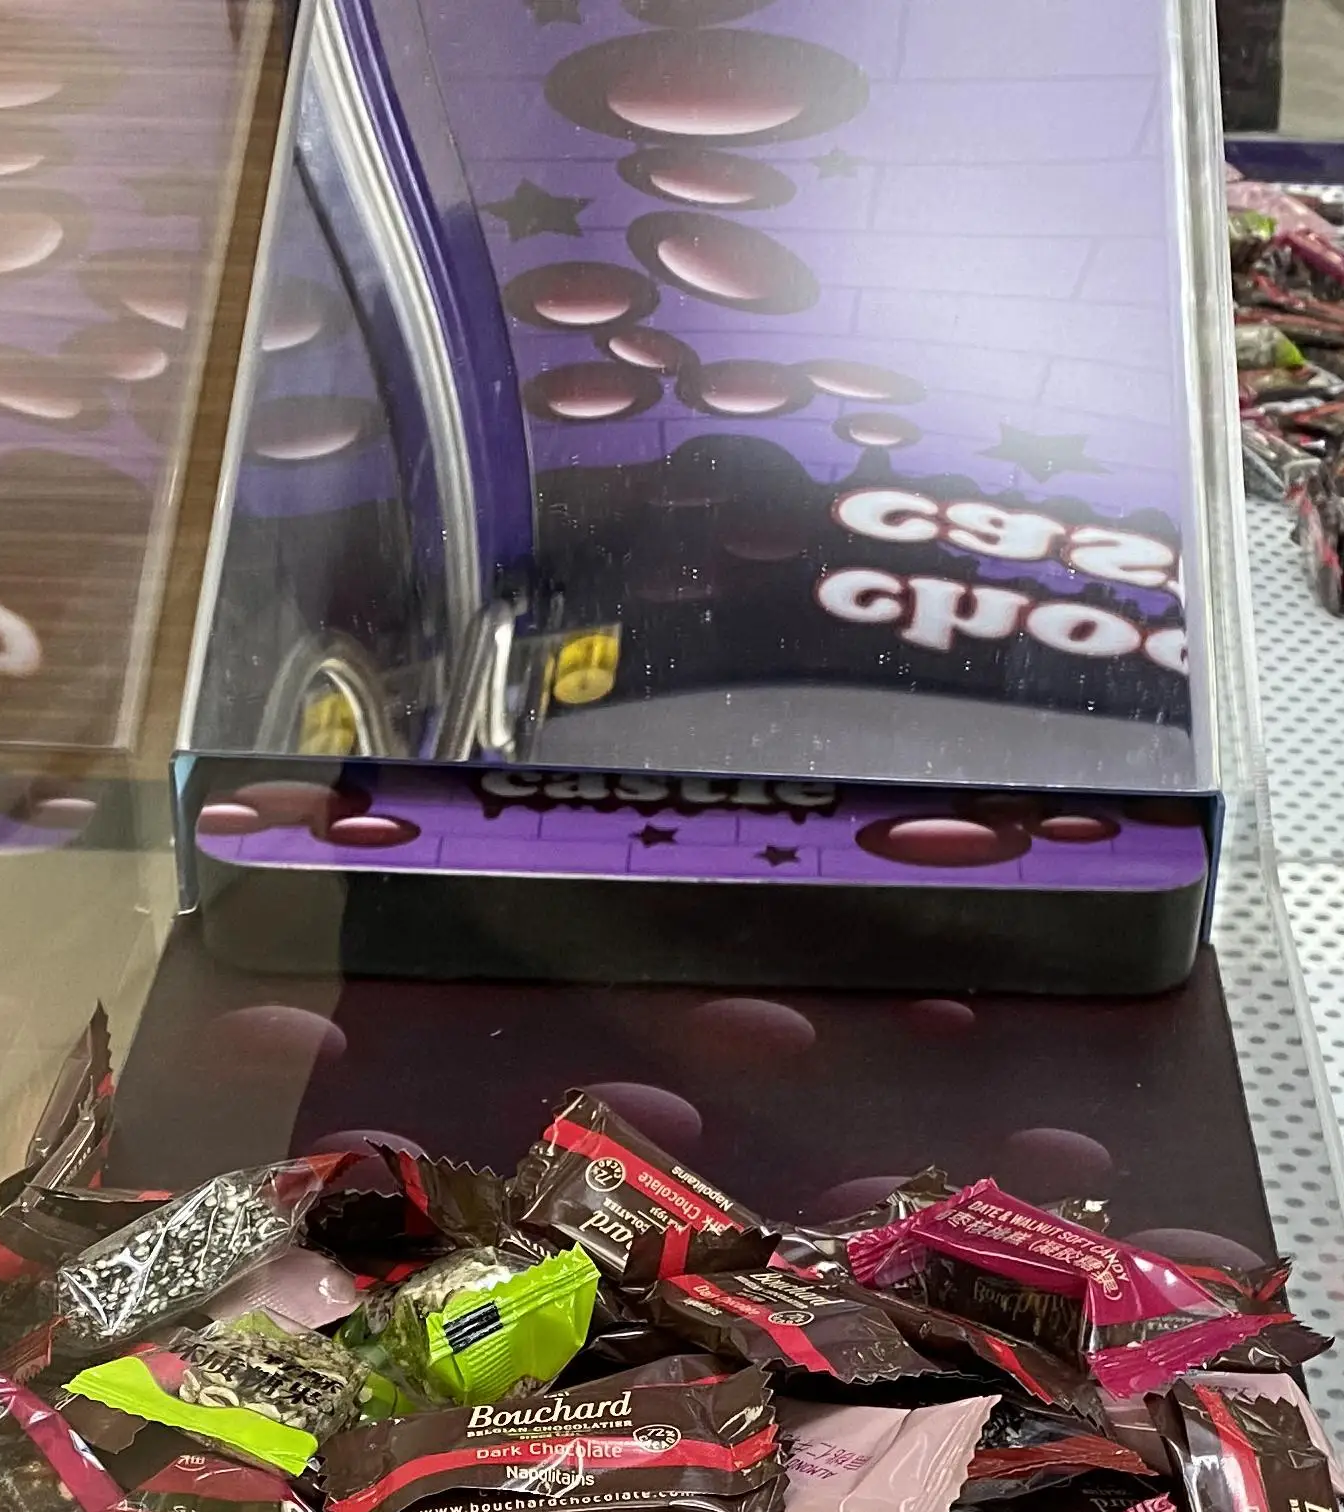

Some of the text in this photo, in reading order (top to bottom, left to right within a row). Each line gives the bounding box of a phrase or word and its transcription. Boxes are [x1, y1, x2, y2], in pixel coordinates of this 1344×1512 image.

[671, 1164, 734, 1213] Napolitains
[967, 1200, 1001, 1220] DATE
[998, 1210, 1012, 1222] &
[1011, 1212, 1061, 1241] WALNUT
[1058, 1229, 1094, 1251] SOFT
[467, 1390, 632, 1429] Bouchard
[476, 1440, 624, 1460] Dark Chocolate
[506, 1465, 595, 1487] Napolitains
